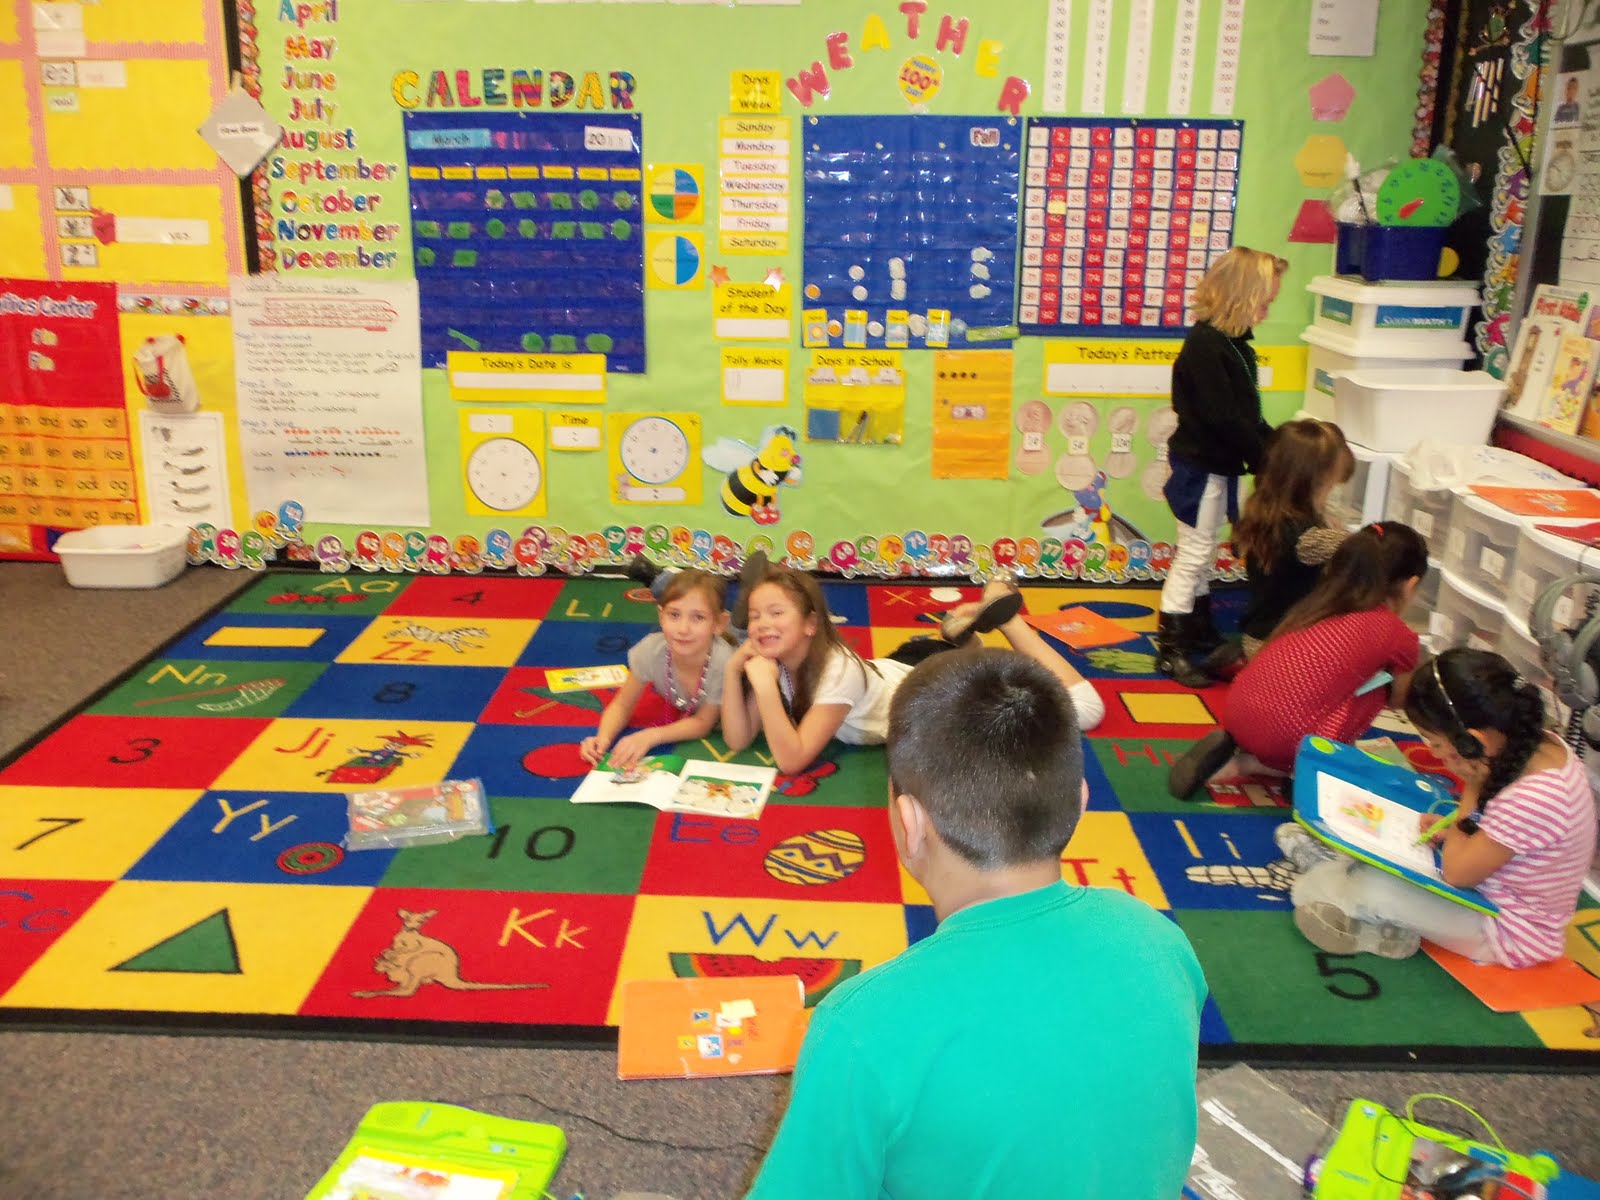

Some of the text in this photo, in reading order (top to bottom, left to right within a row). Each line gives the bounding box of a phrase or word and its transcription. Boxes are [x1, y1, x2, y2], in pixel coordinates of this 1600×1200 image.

[278, 0, 339, 27] April
[284, 35, 336, 61] May
[785, 0, 1031, 115] WEATHER
[281, 67, 337, 91] June
[392, 68, 637, 109] CALENDAR
[289, 98, 337, 126] July
[277, 126, 356, 152] August
[736, 122, 774, 134] Sunday
[735, 141, 775, 154] Monday
[271, 156, 398, 185] September
[734, 159, 776, 174] Tuesday
[725, 180, 785, 193] Wednesday
[280, 189, 382, 214] October
[730, 198, 779, 211] Thursday
[277, 219, 400, 242] November
[736, 217, 771, 231] Friday
[729, 237, 778, 250] Saturday
[281, 247, 398, 270] December
[727, 287, 775, 299] Student
[40, 295, 96, 318] Center
[739, 302, 759, 313] the
[763, 303, 786, 317] Day
[480, 356, 573, 370] Today's Date is
[817, 355, 894, 368] Days in School
[1077, 345, 1129, 361] Today's
[561, 414, 589, 425] Time
[312, 577, 401, 594] Aa
[453, 591, 485, 606] 4
[371, 641, 434, 662] Zz
[147, 663, 228, 686] Nn
[373, 681, 417, 704] 8
[108, 738, 160, 764] 3
[275, 727, 336, 758] Jj
[211, 799, 298, 841] Yy
[669, 811, 760, 845] Ee
[14, 816, 84, 850] 7
[487, 824, 576, 861] 10
[1060, 858, 1136, 896] Tt
[498, 907, 589, 949] Kk
[701, 911, 839, 949] Ww
[1313, 952, 1381, 1001] 5
